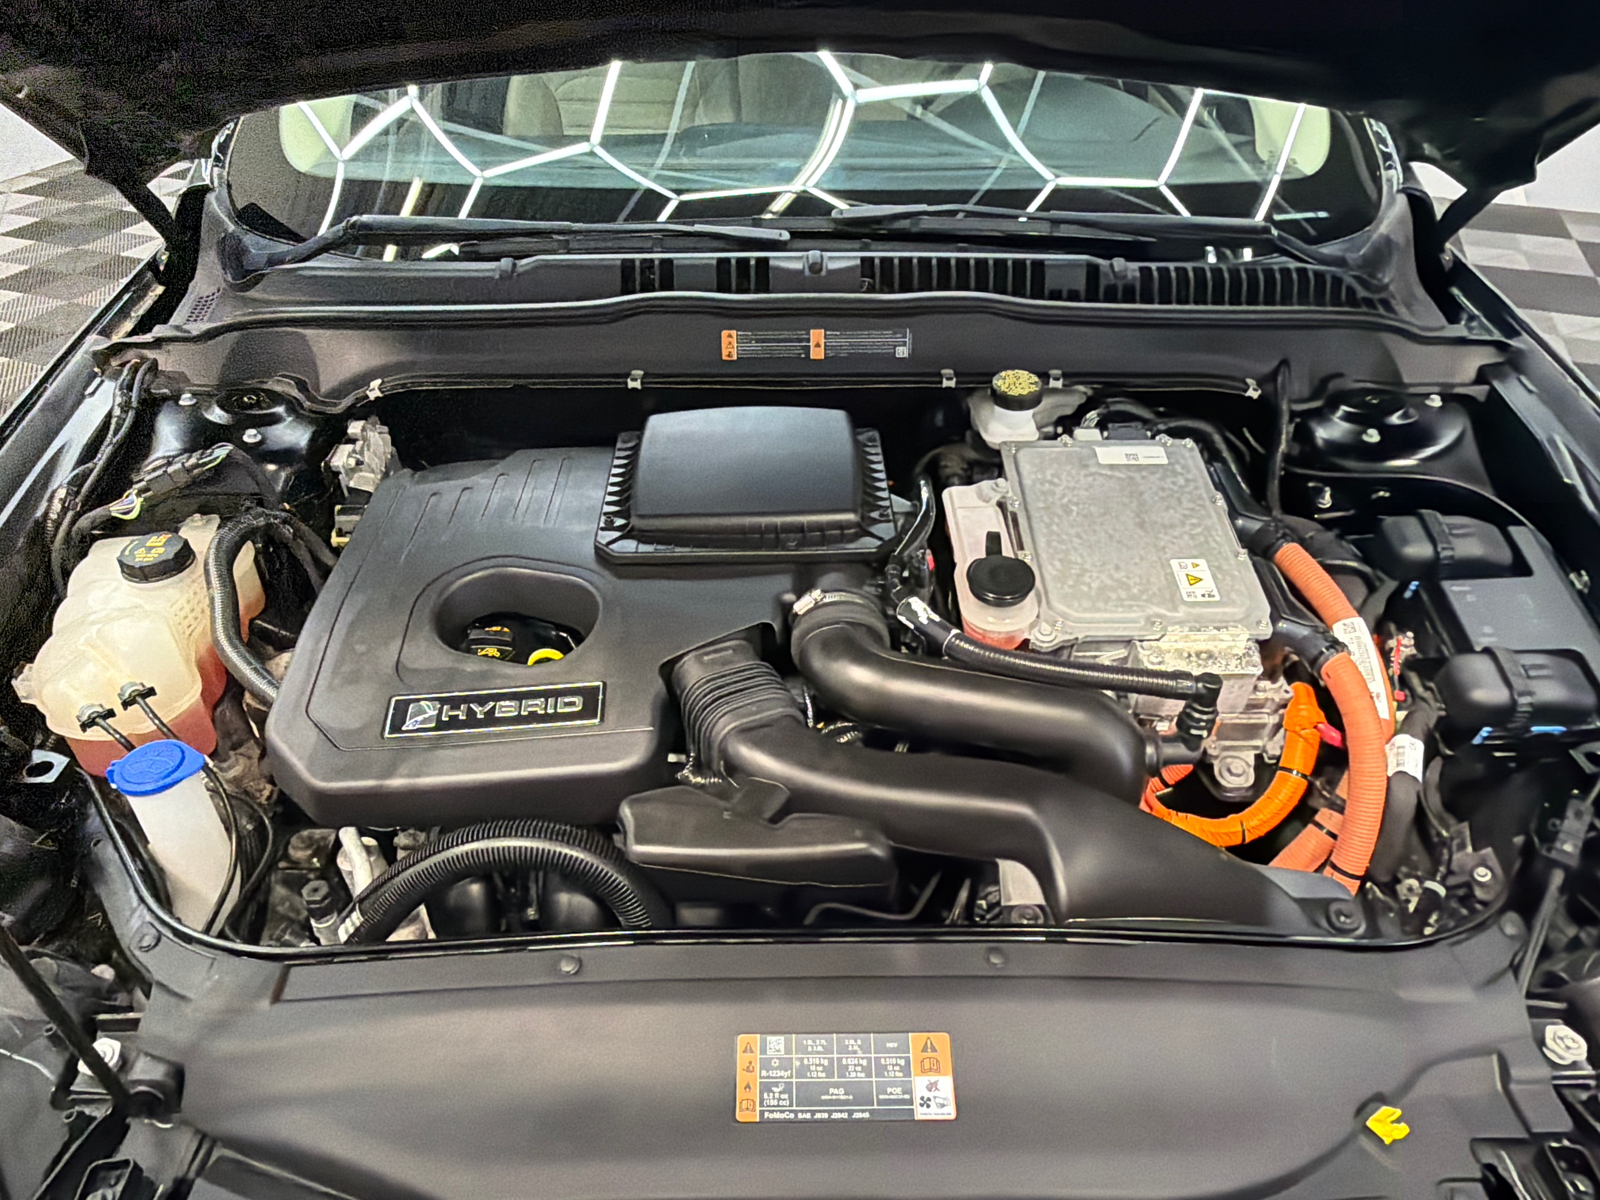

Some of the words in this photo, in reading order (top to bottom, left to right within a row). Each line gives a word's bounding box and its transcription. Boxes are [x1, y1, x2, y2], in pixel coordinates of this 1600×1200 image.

[441, 695, 584, 721] HYBRID
[820, 1058, 828, 1066] kg
[859, 1058, 867, 1066] kg
[897, 1058, 905, 1066] kg
[761, 1070, 791, 1078] R-1234yf
